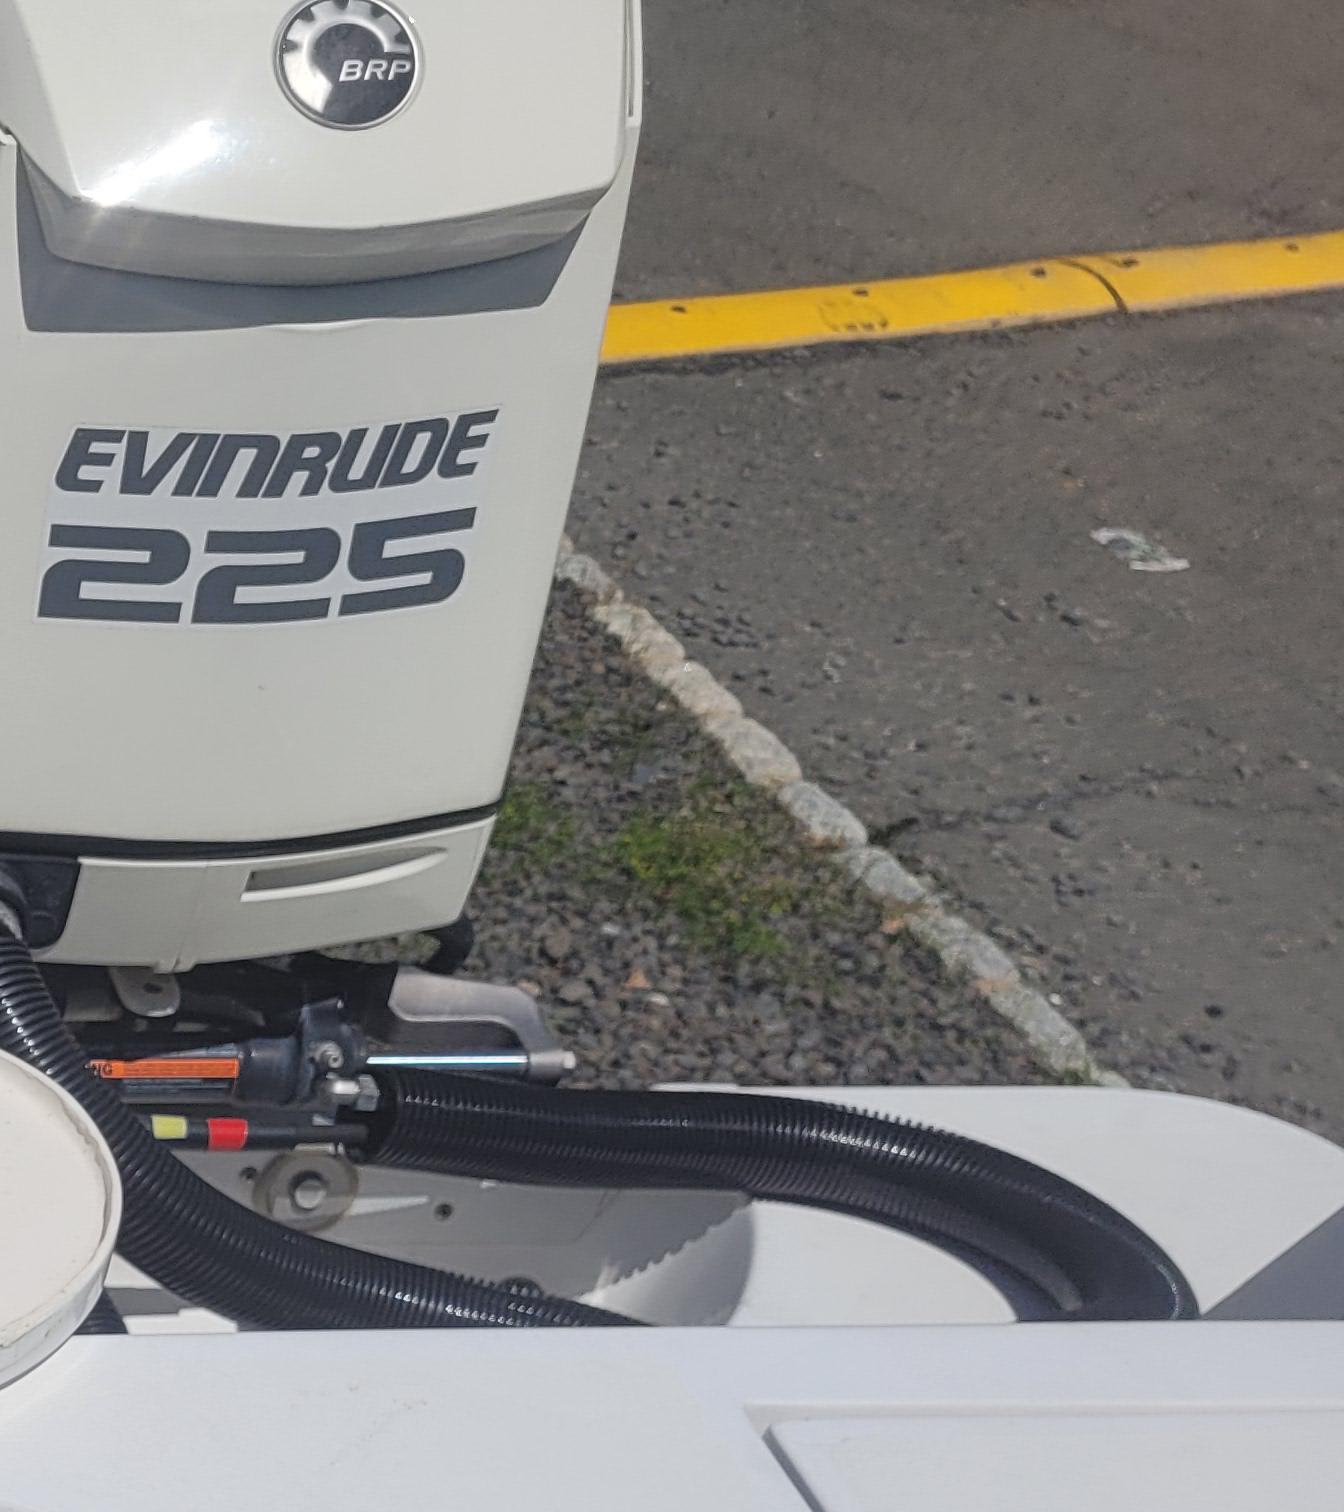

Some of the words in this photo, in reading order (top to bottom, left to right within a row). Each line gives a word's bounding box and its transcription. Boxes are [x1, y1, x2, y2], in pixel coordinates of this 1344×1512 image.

[338, 58, 412, 82] BRP
[54, 408, 500, 499] EVINRUDE
[37, 506, 478, 625] 225
